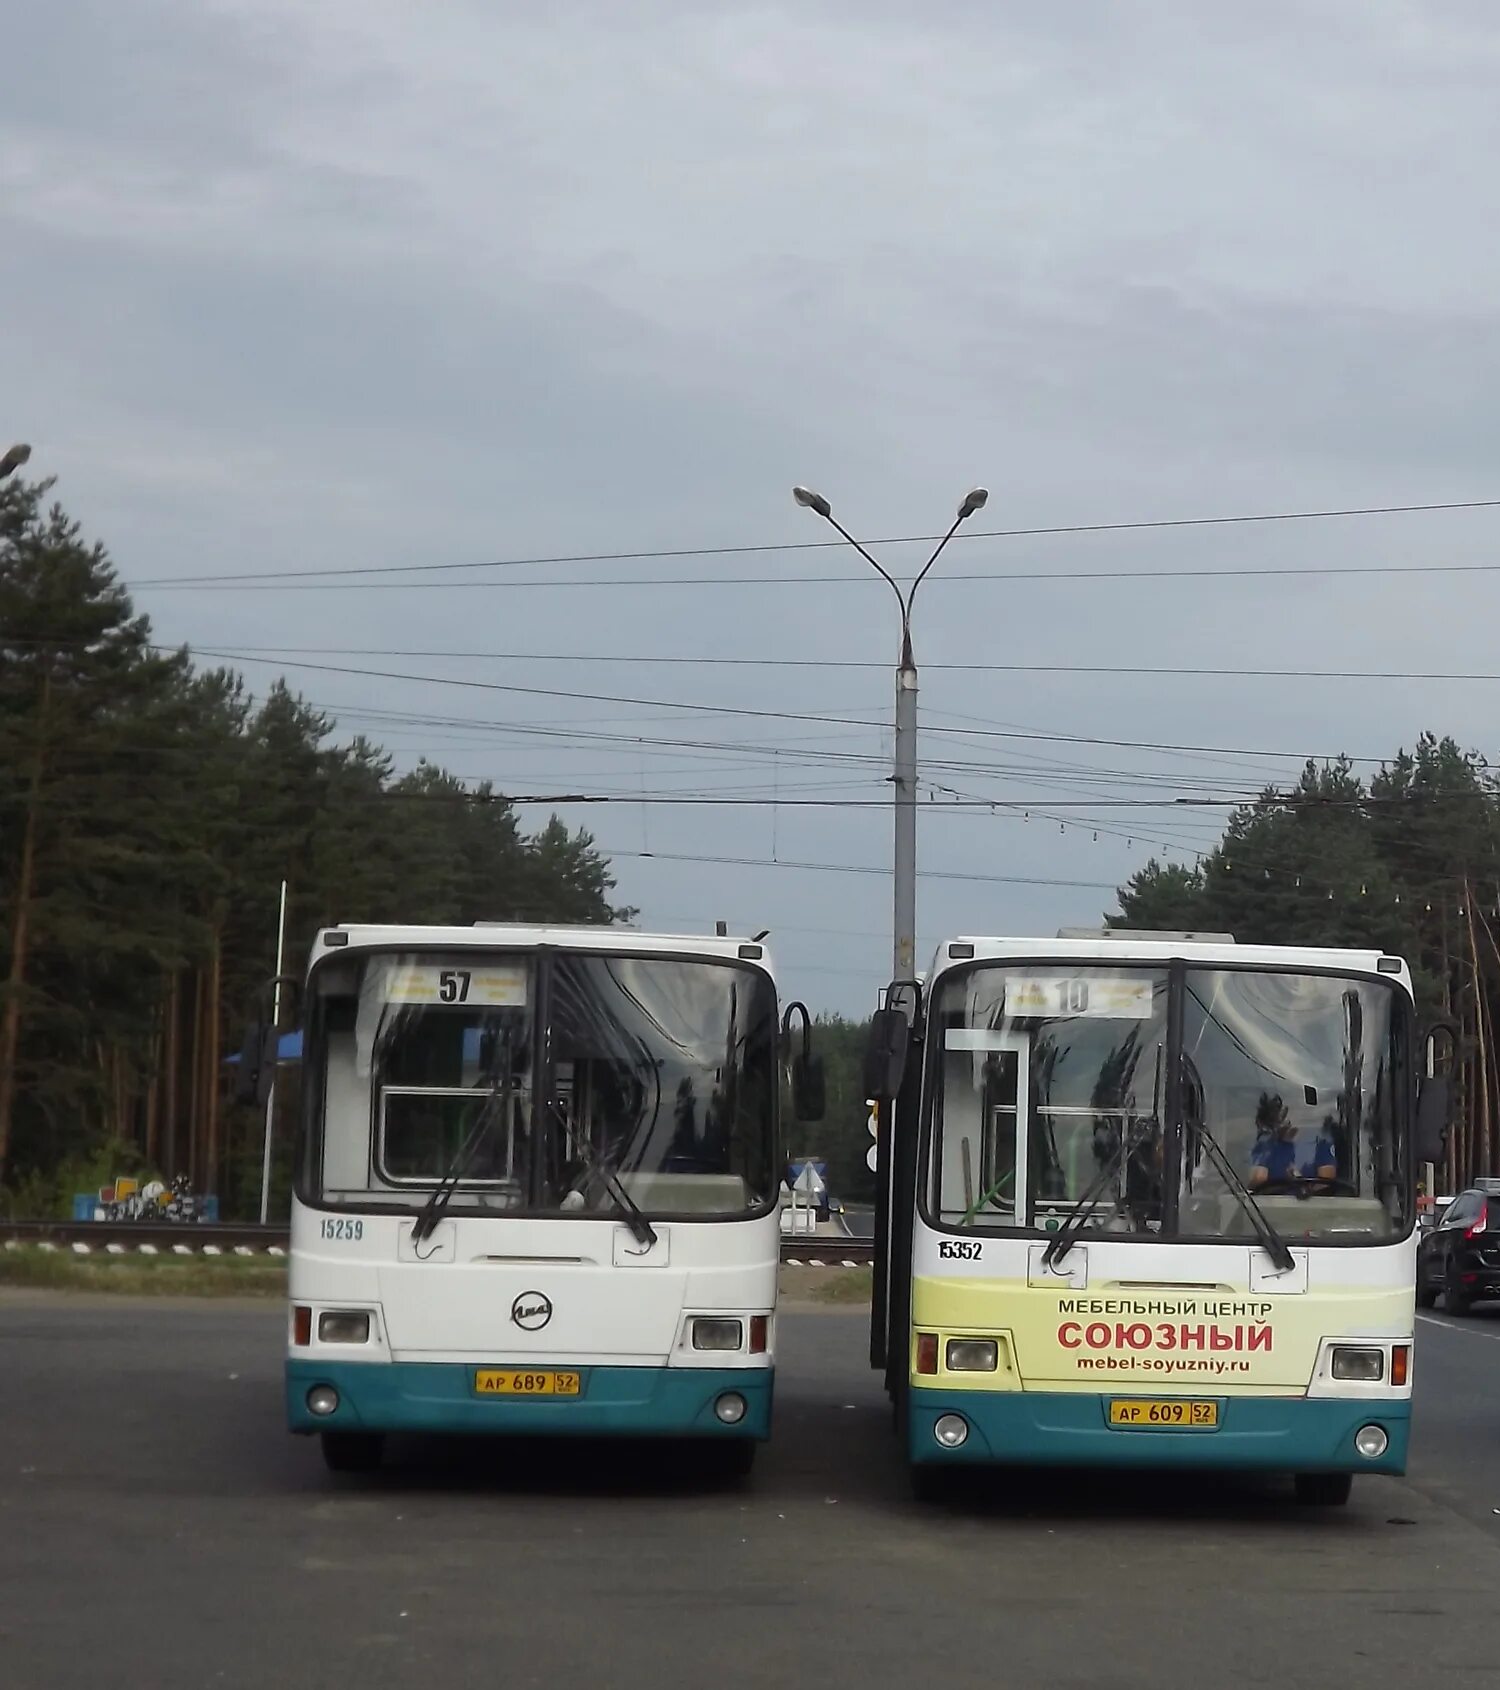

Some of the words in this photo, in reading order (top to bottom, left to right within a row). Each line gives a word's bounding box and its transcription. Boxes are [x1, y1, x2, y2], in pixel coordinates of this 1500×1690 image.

[439, 970, 471, 1002] 57
[1055, 979, 1088, 1013] 10
[321, 1219, 363, 1241] 15259
[937, 1241, 982, 1260] 15352
[1058, 1299, 1202, 1316] МЕБЕЛЬНЫЙ
[1203, 1303, 1273, 1318] ЦЕНТР
[1057, 1319, 1273, 1351] СОЮЗНЫЙ
[1077, 1356, 1250, 1374] mebel-soyuzniy.ru
[485, 1377, 506, 1390] АР
[512, 1374, 546, 1390] 689
[556, 1375, 574, 1387] 52
[1119, 1408, 1141, 1421] АР
[1149, 1405, 1183, 1422] 609
[1193, 1405, 1211, 1417] 52
